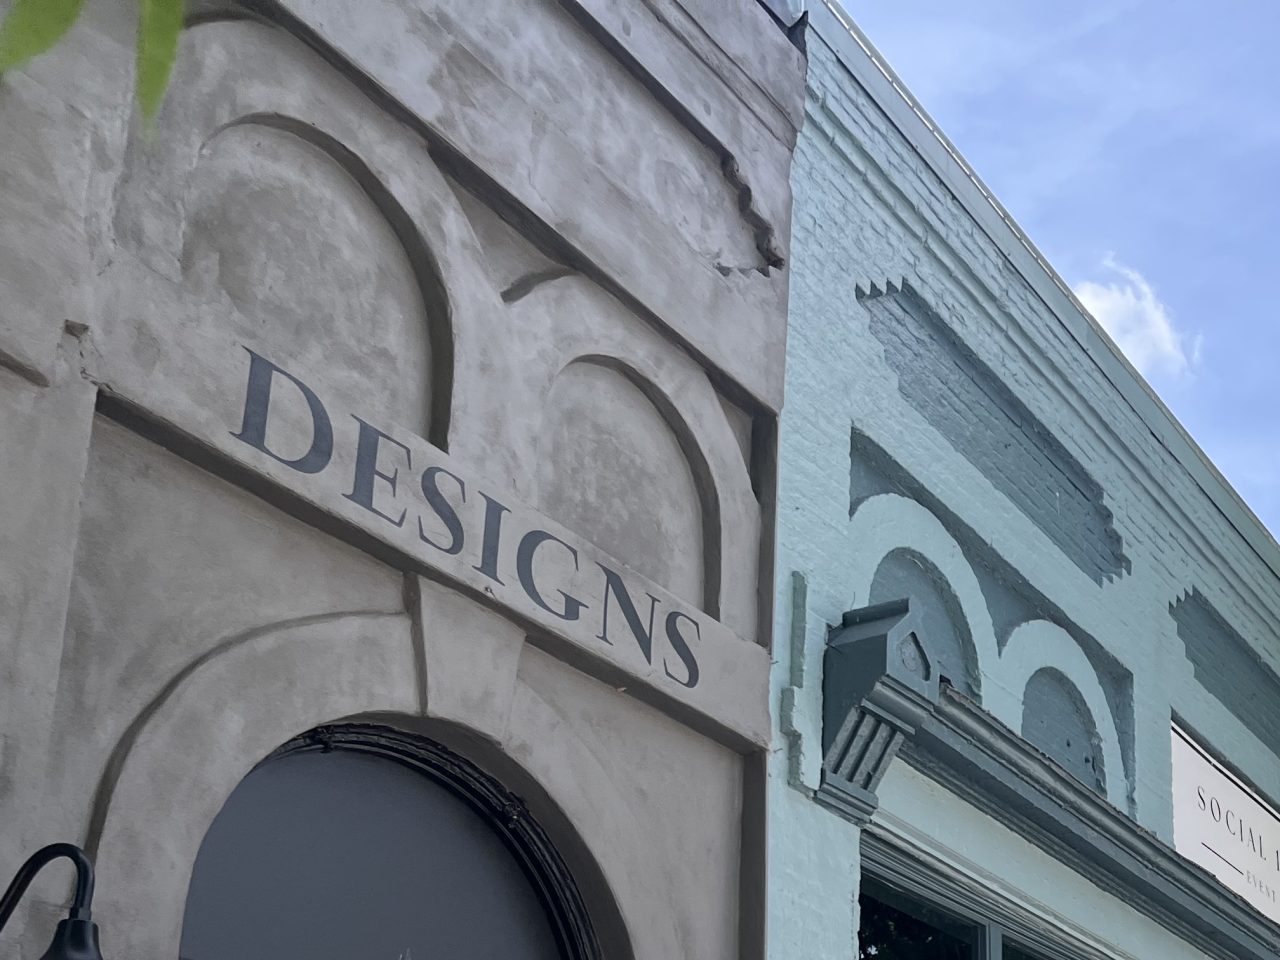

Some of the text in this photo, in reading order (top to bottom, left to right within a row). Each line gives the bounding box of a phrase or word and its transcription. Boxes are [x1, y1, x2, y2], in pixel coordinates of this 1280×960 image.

[229, 345, 700, 688] DESIGNS
[1197, 786, 1267, 861] SOCIAL
[1246, 870, 1276, 903] EVENT
